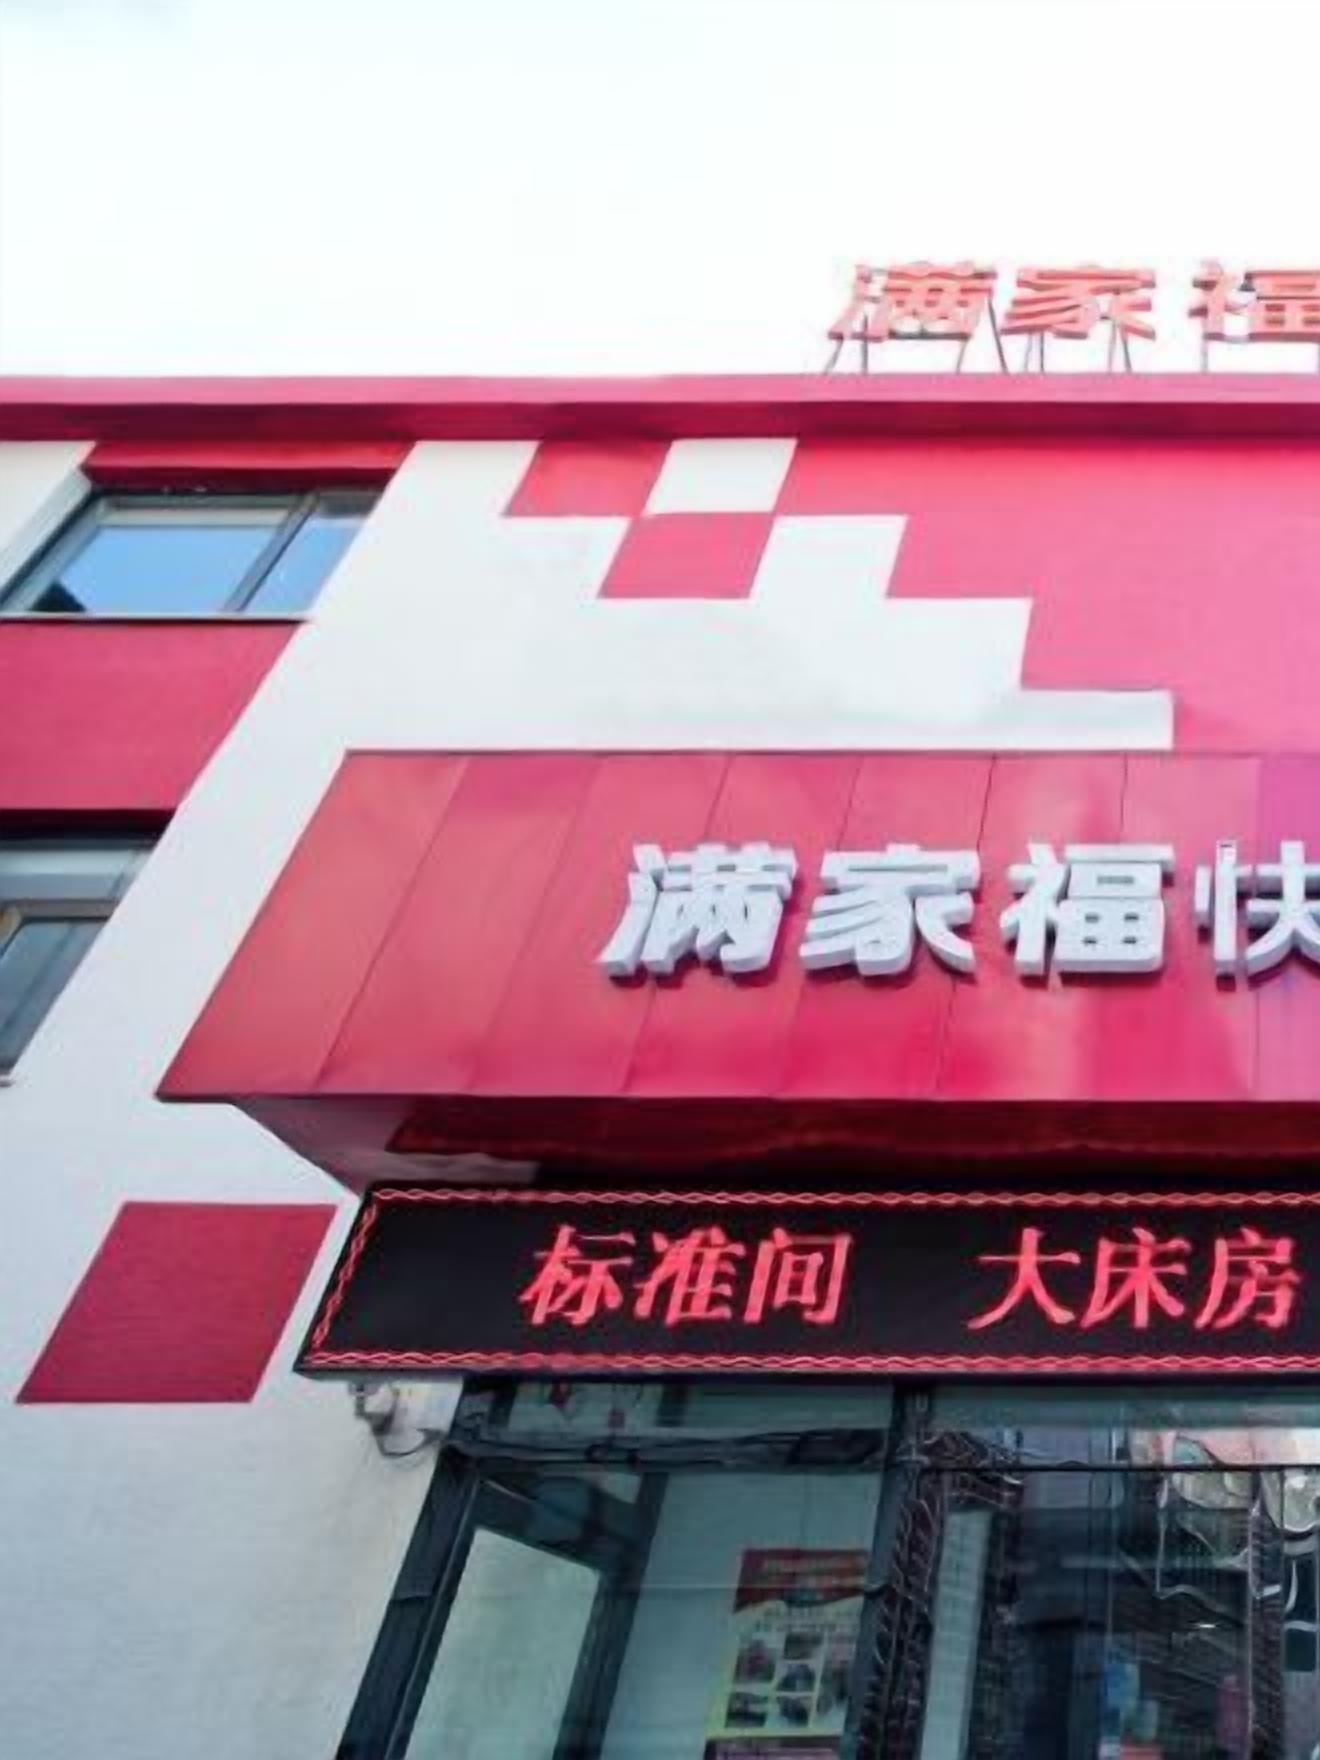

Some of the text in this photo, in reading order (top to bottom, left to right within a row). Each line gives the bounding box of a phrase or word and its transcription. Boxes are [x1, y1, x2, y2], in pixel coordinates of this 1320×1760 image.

[518, 1224, 853, 1328] 标准间
[966, 1226, 1304, 1332] 大床房
